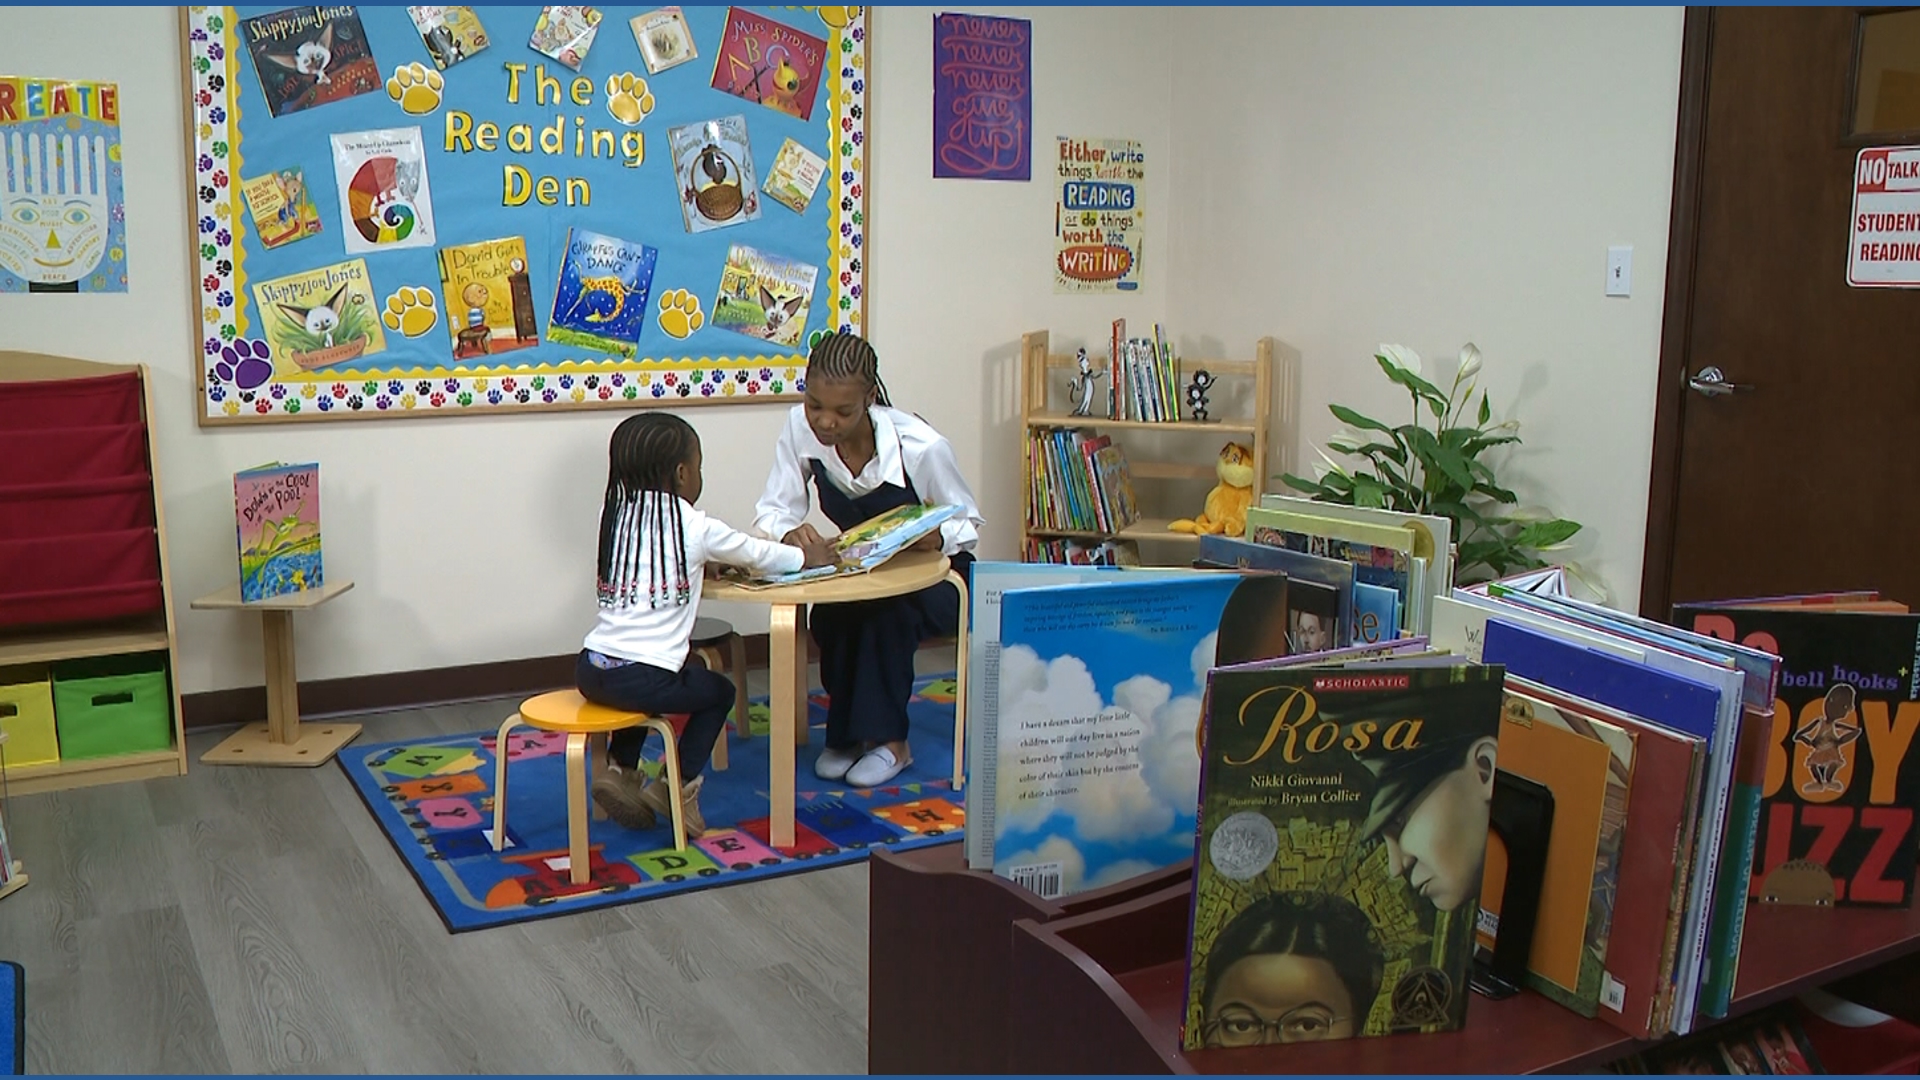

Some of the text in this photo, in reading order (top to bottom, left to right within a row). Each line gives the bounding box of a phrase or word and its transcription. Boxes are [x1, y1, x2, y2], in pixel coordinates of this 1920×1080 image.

[941, 16, 1024, 41] never
[941, 42, 1024, 66] never
[504, 61, 595, 106] The
[941, 68, 1024, 91] never
[951, 97, 1014, 141] give
[444, 109, 646, 168] Reading
[1111, 147, 1144, 163] write
[1058, 163, 1092, 180] things
[1127, 168, 1144, 179] the
[1859, 157, 1919, 186] NO TALK
[502, 163, 592, 207] Den
[1081, 212, 1097, 227] do
[1100, 212, 1134, 231] things
[1062, 228, 1124, 243] worth the
[453, 248, 492, 269] David
[587, 257, 626, 274] DANCE
[324, 266, 362, 291] Jones
[457, 261, 511, 286] In Trouble
[1326, 677, 1407, 689] SCHOLASTIC
[1782, 670, 1825, 688] bell
[1832, 665, 1898, 691] hooks
[1223, 684, 1425, 767] Rosa
[1020, 737, 1049, 748] children
[1079, 733, 1090, 743] day
[1251, 772, 1342, 788] Nikki Giovanni
[1281, 791, 1317, 807] Bryan
[1320, 789, 1361, 803] Collier
[712, 836, 746, 853] E
[650, 855, 689, 872] D
